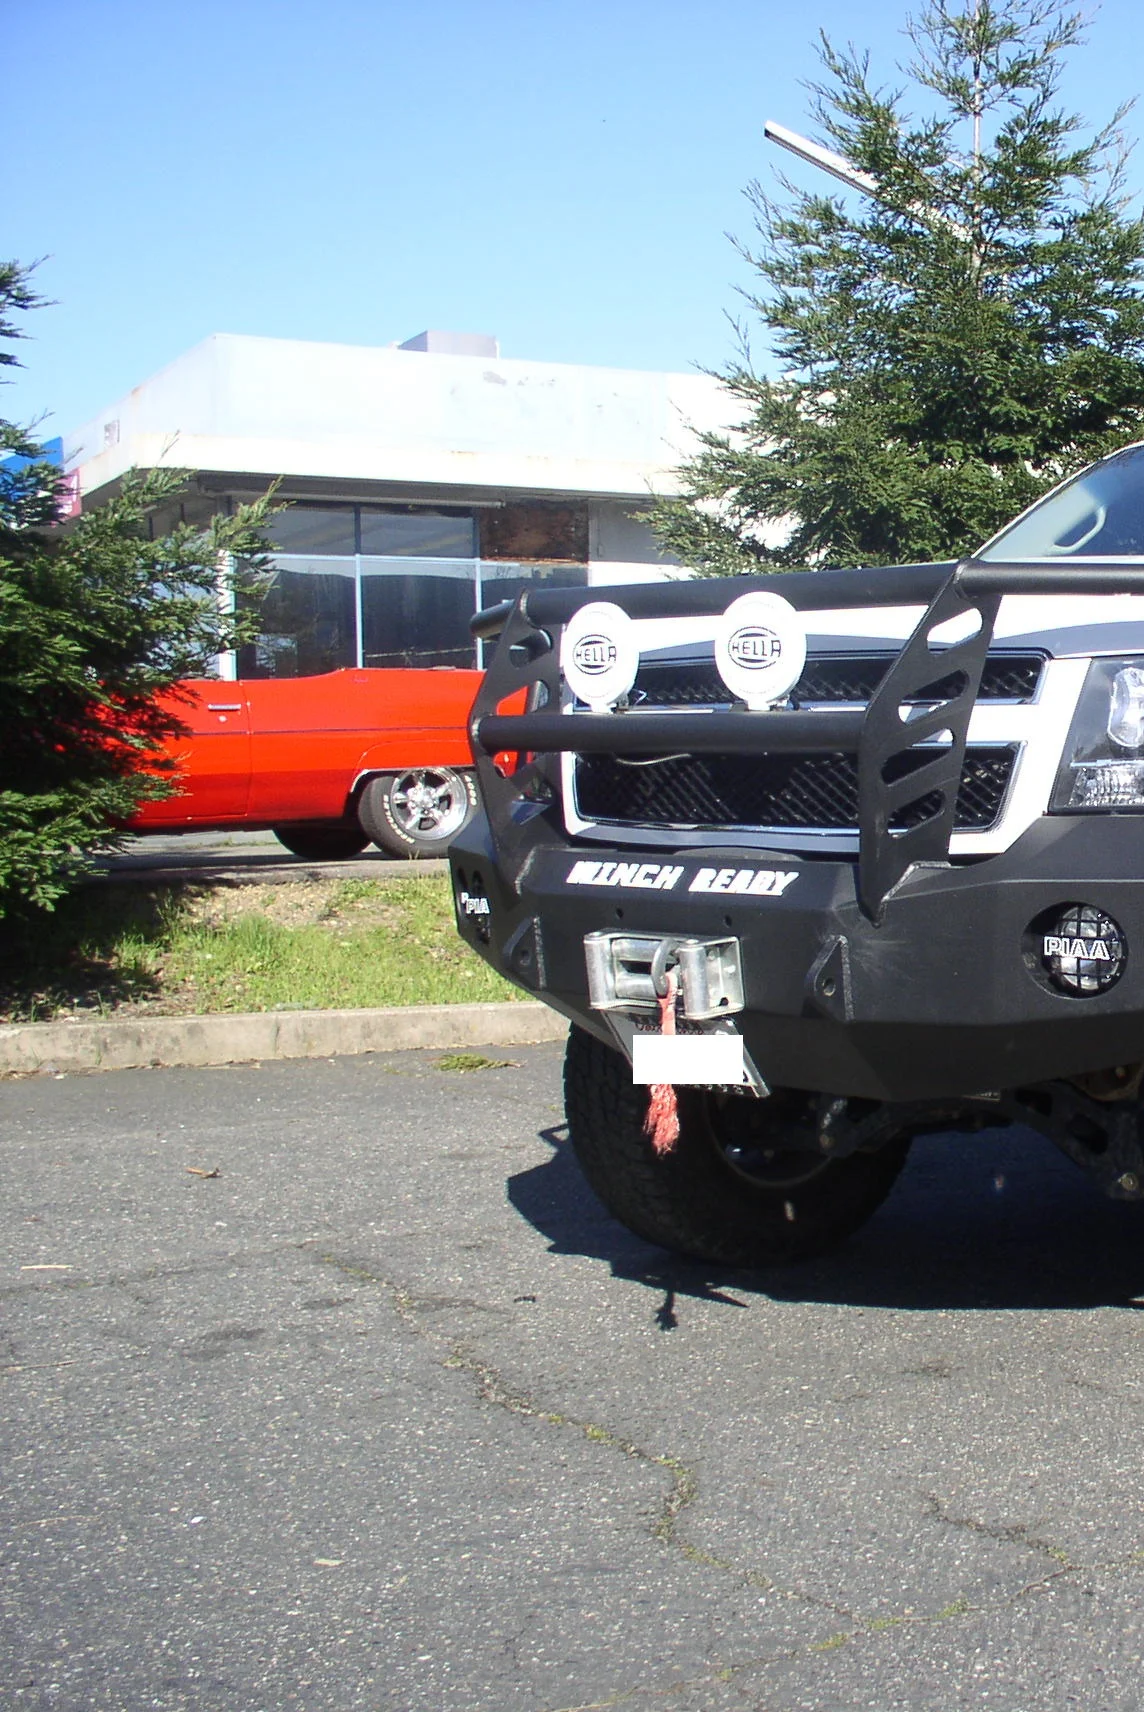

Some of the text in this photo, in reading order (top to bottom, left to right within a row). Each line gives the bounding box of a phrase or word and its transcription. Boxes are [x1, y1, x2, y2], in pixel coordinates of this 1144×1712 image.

[575, 645, 617, 662] HELLA
[732, 640, 782, 658] HELLA
[566, 860, 800, 896] WINCH READY
[1043, 935, 1111, 960] PIAA
